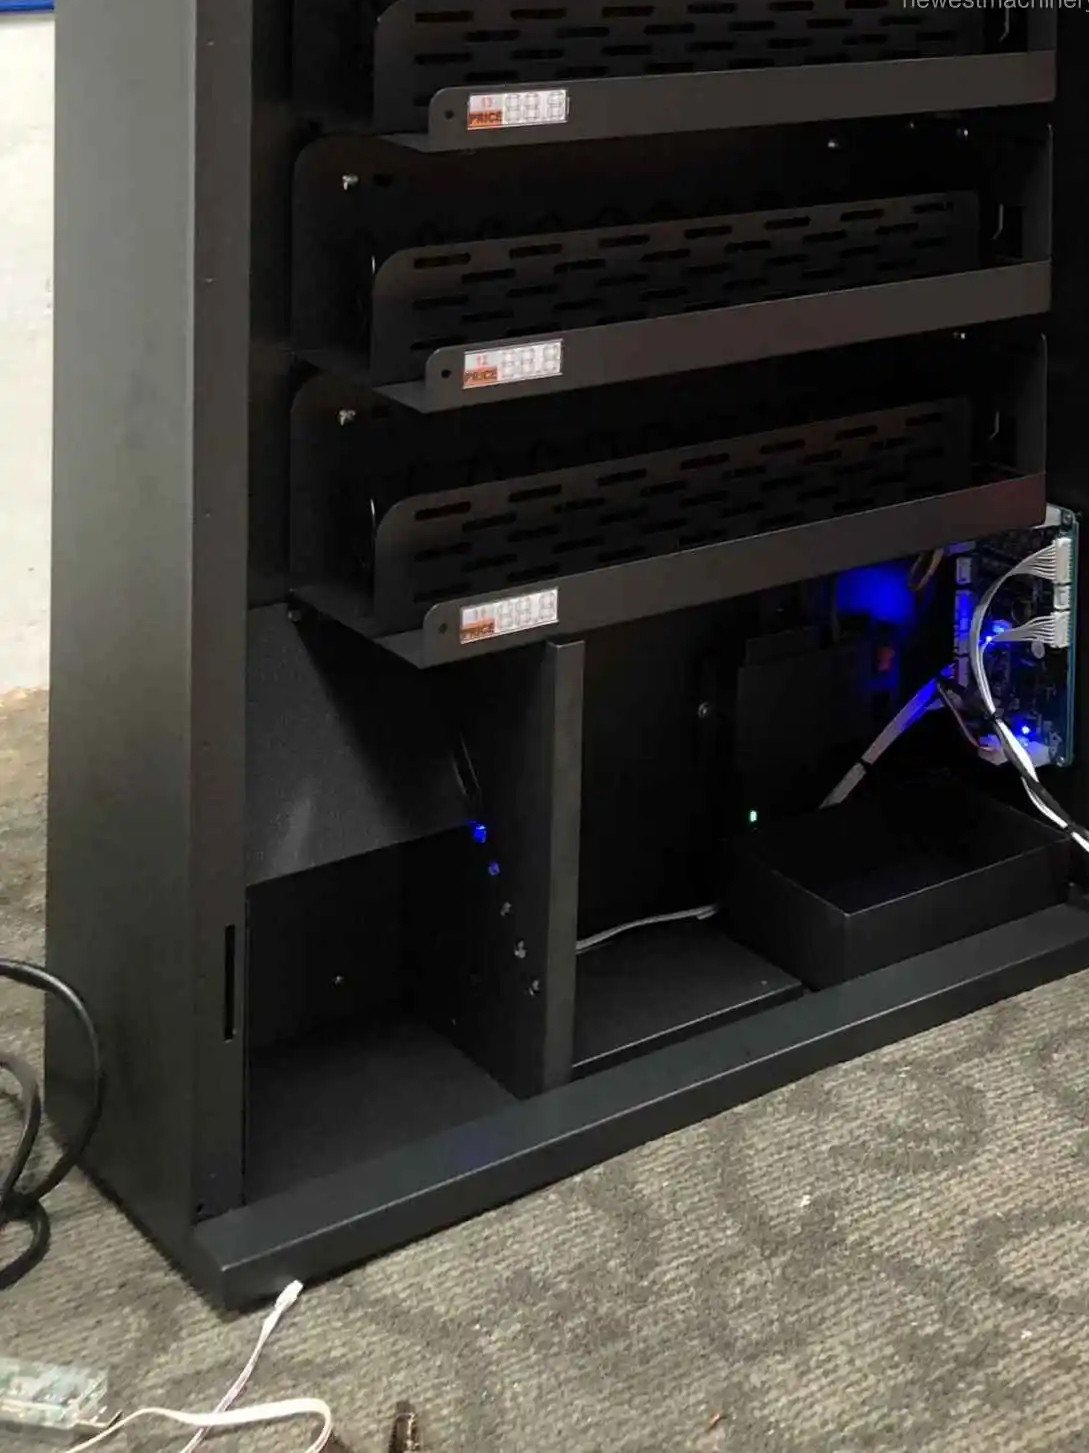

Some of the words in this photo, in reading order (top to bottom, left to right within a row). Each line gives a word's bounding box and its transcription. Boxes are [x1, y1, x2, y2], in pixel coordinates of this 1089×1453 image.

[468, 110, 503, 125] PRICE
[463, 368, 498, 383] PRICE
[461, 622, 496, 639] PRICE
